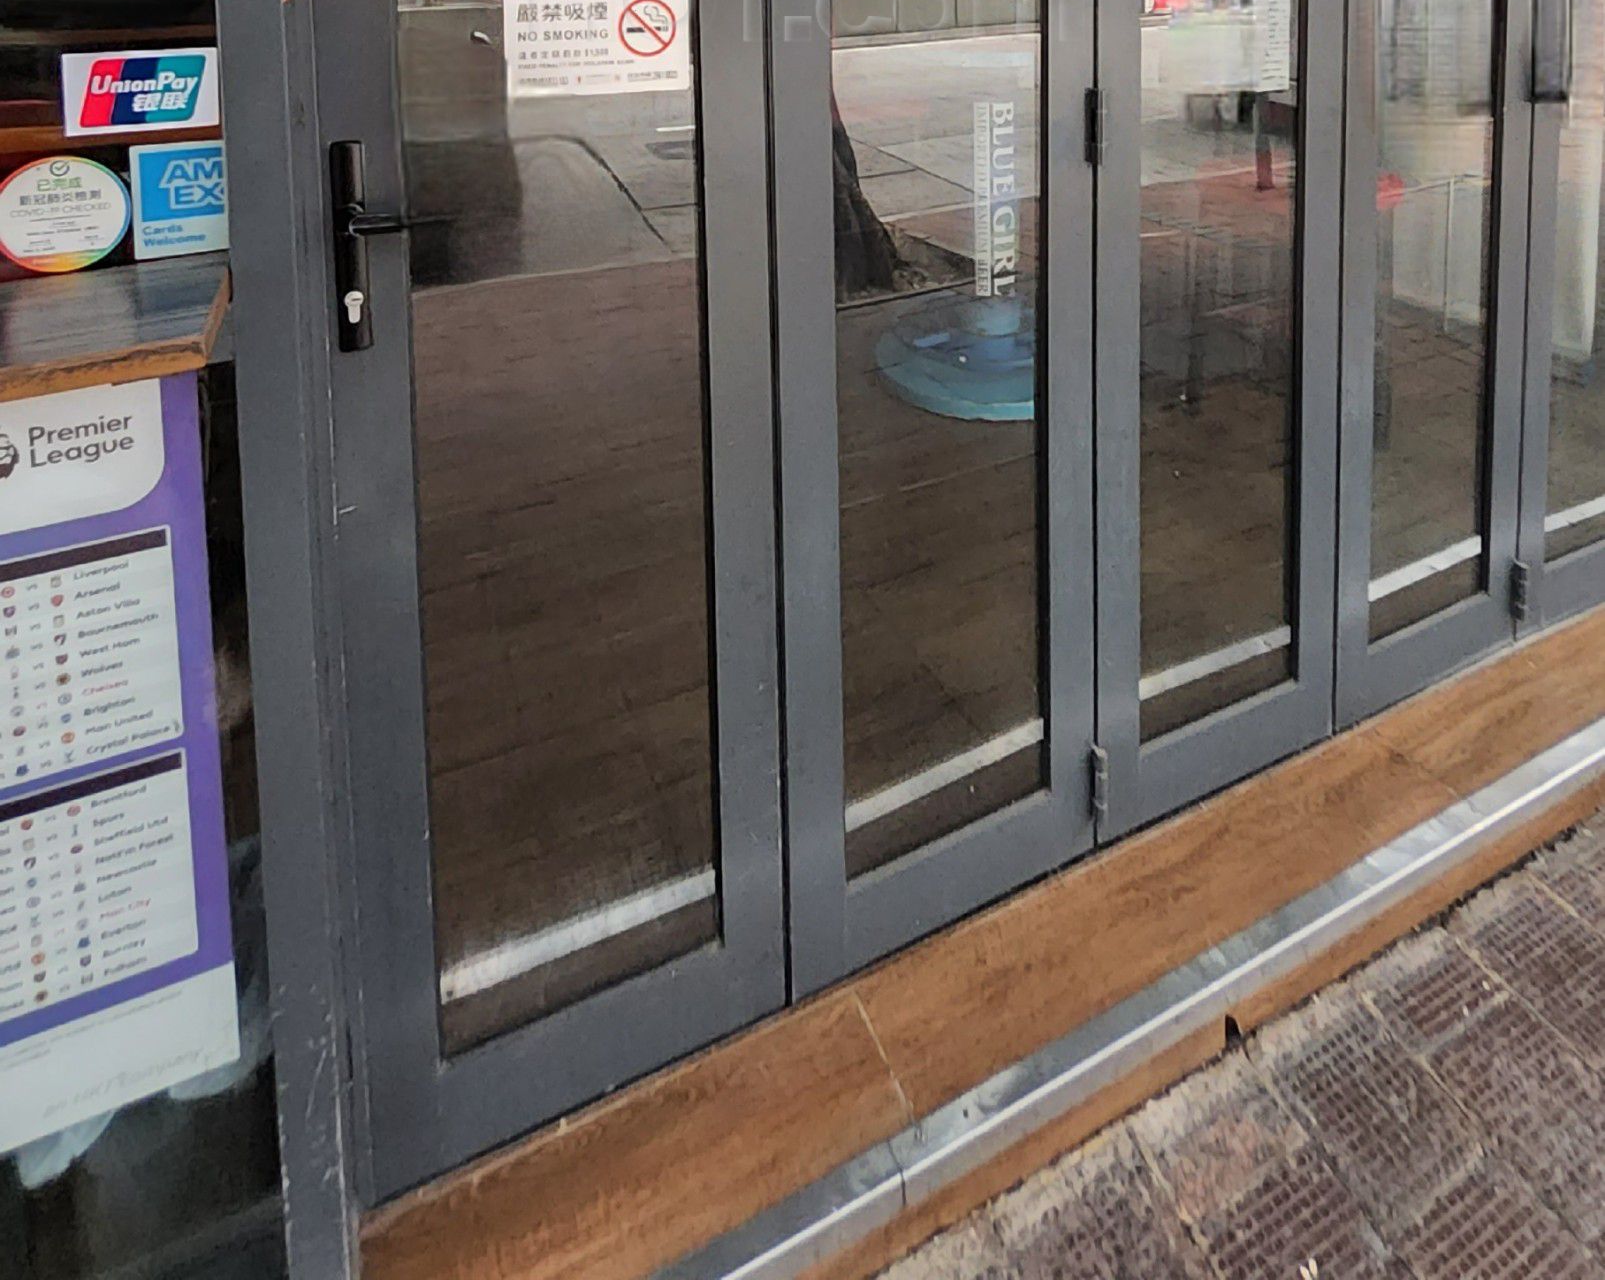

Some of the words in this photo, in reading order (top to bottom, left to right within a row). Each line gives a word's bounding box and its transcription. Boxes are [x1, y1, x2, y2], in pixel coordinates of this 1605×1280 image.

[516, 1, 609, 23] 嚴禁吸煙
[517, 31, 538, 43] NO
[543, 29, 610, 42] SMOKING
[90, 70, 199, 107] UnionPay
[131, 92, 189, 113] 银联
[991, 101, 1016, 197] BLUE
[142, 222, 184, 237] Cards
[143, 231, 206, 249] Welcome
[991, 205, 1016, 298] GIRL
[977, 260, 989, 293] BEER
[28, 414, 134, 448] Premier
[29, 433, 135, 470] League
[74, 561, 129, 580] Liverpool
[74, 582, 121, 600] Arsenal
[76, 607, 111, 619] Aston
[114, 598, 141, 609] Villa
[78, 613, 159, 639] Bournemouth
[79, 645, 109, 658] West
